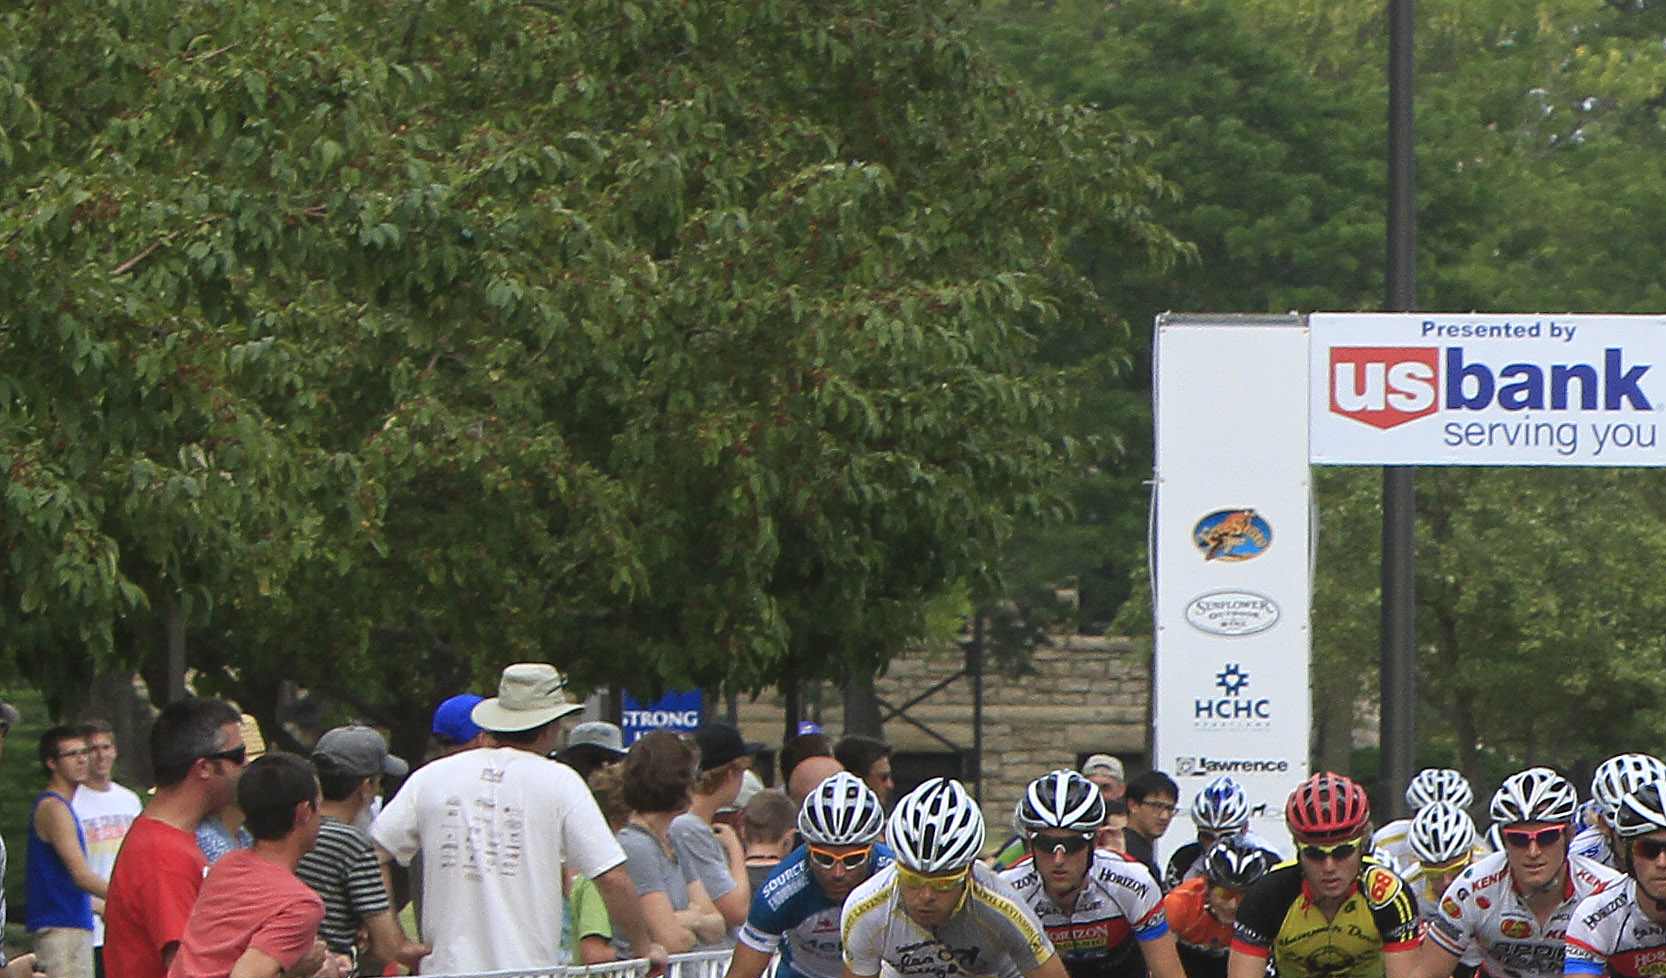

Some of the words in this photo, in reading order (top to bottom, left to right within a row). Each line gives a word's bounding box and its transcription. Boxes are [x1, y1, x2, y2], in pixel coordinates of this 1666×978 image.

[1422, 321, 1541, 338] Presented
[1550, 321, 1577, 342] by
[1444, 415, 1578, 455] serving
[1592, 423, 1656, 455] you
[1195, 700, 1270, 719] HCHC
[1192, 757, 1288, 776] Lawrence
[1099, 867, 1149, 899] HORIZON
